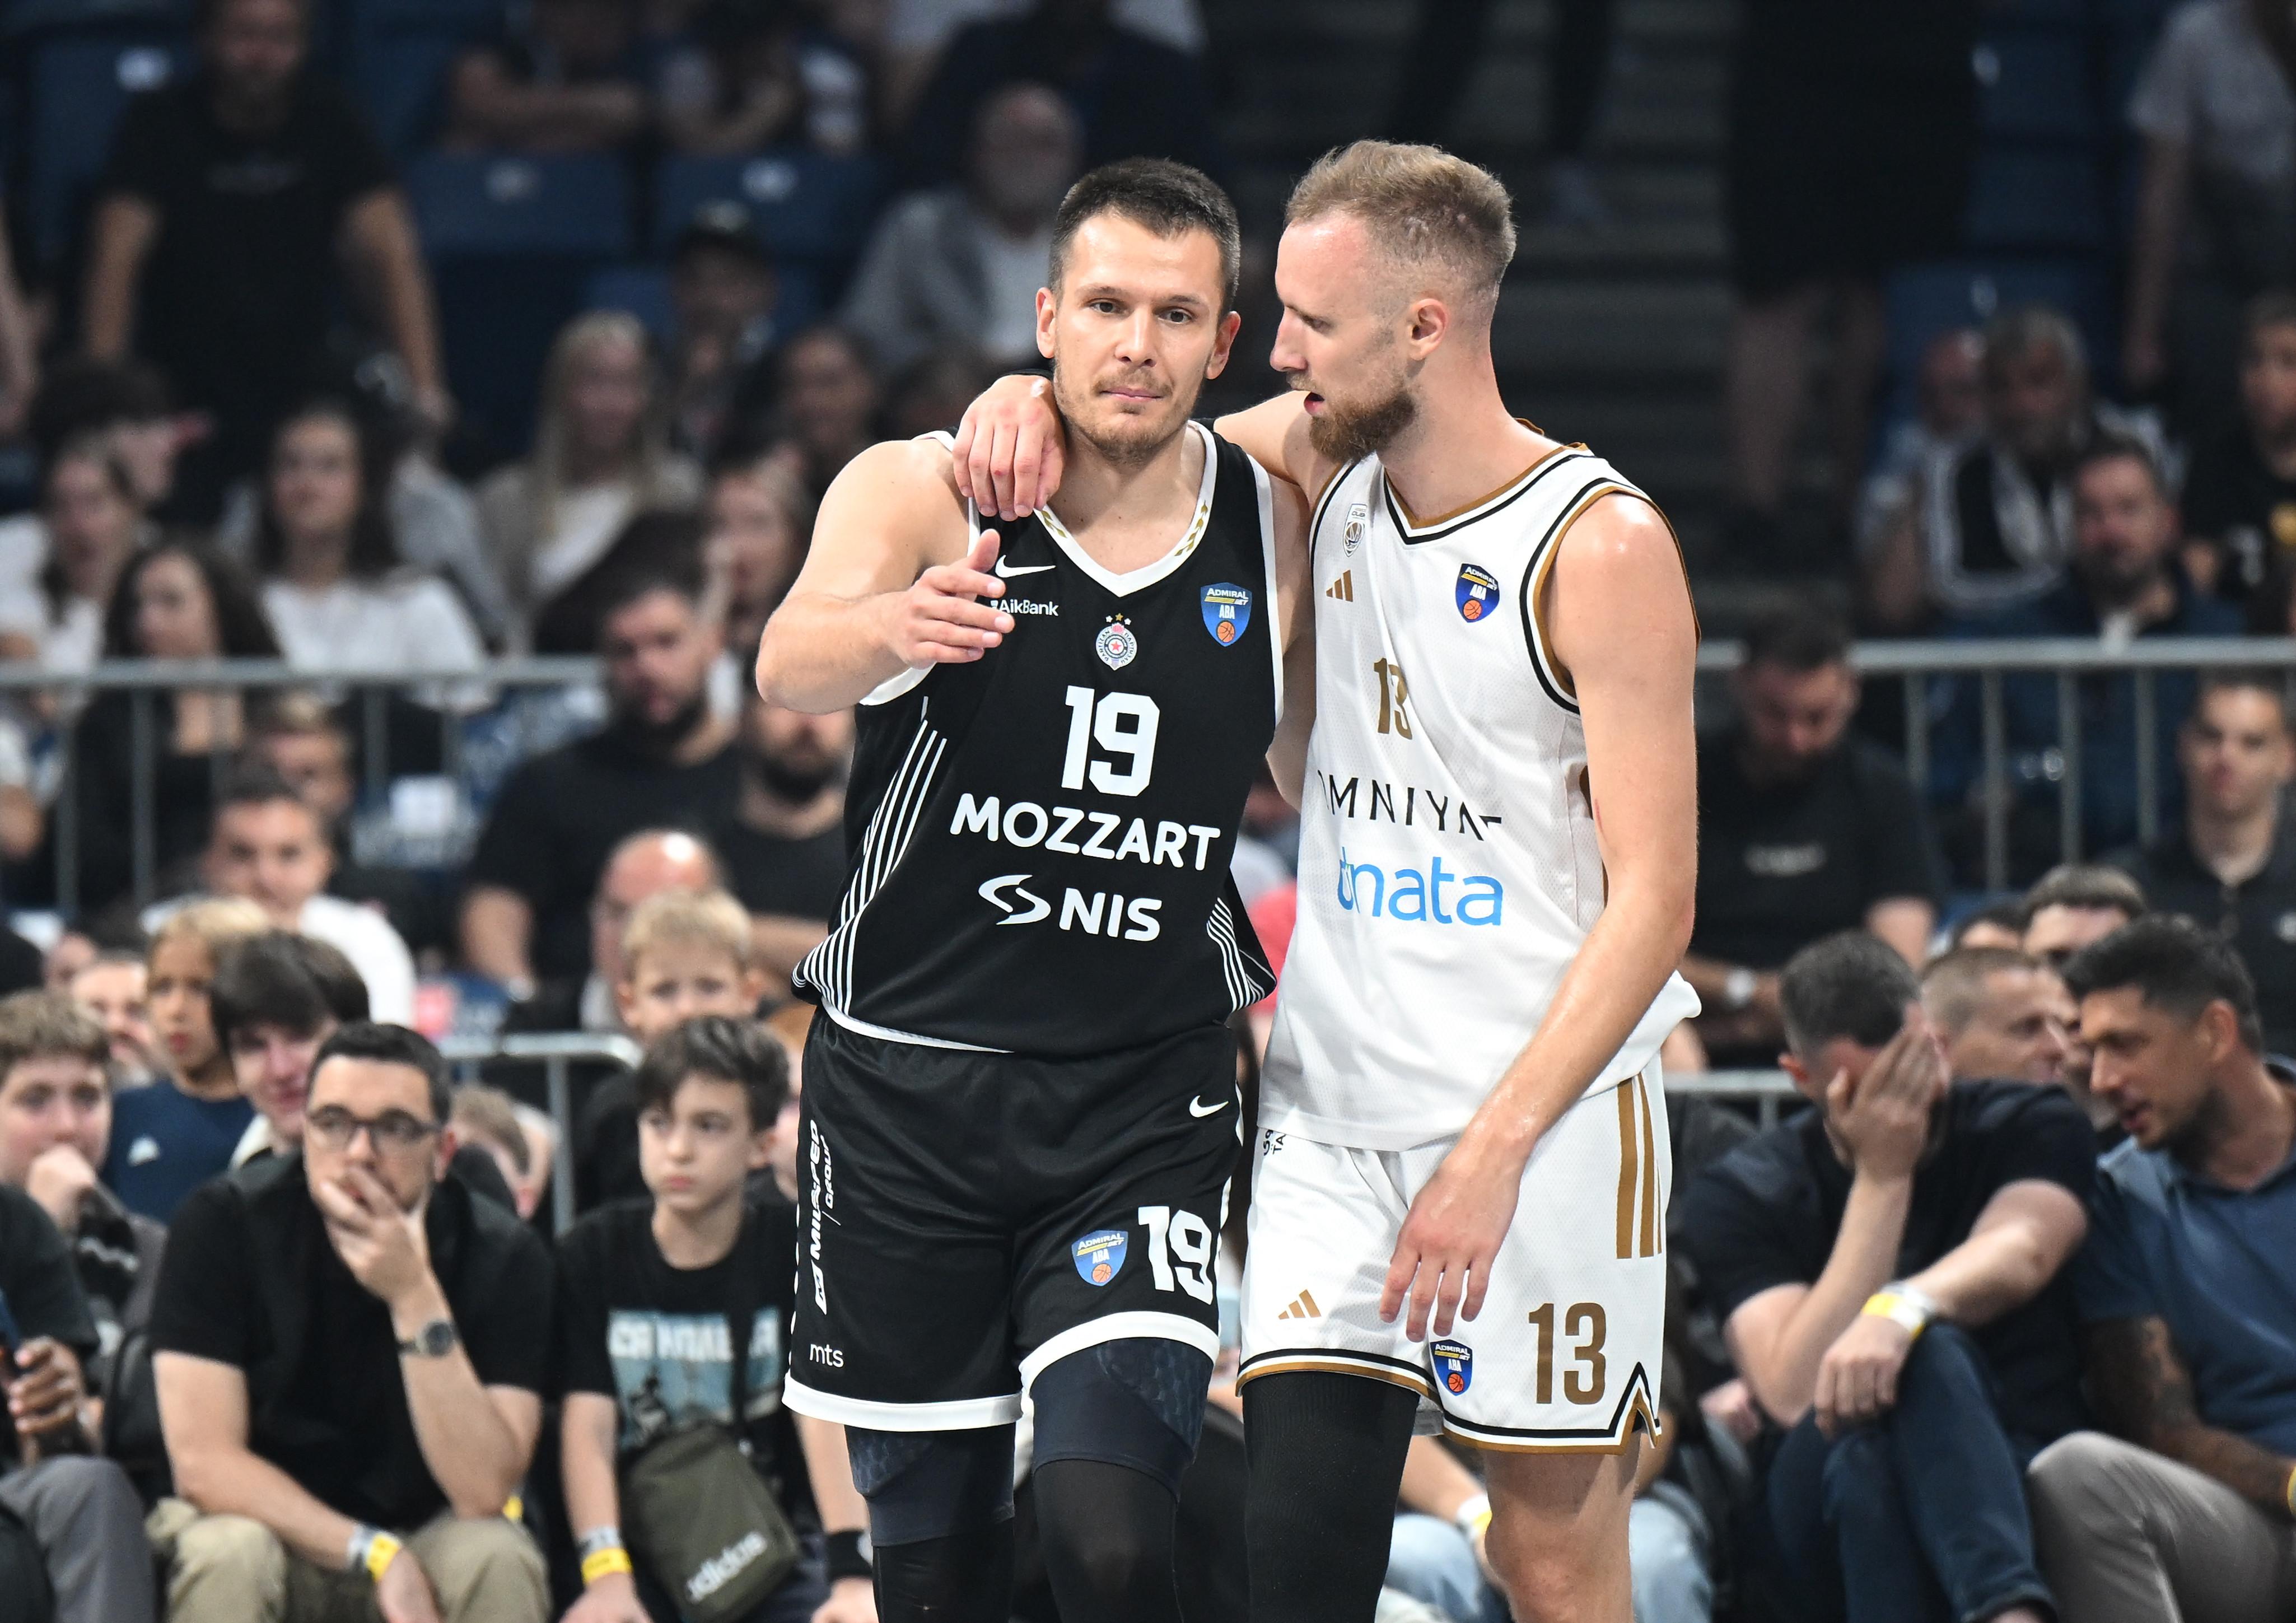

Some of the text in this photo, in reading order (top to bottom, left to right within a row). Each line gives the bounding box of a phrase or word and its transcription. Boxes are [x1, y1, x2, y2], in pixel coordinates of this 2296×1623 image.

[1464, 566, 1497, 587] ADMIRAL
[1207, 587, 1249, 600] ADMIRAL
[1469, 584, 1487, 600] ABA
[998, 599, 1059, 617] AikBank
[1219, 604, 1235, 619] ABA
[1061, 685, 1160, 797] 19
[949, 792, 1221, 871] MOZZART
[1058, 887, 1163, 941] NIS
[1077, 1233, 1125, 1251] ADMIRAL
[1092, 1248, 1110, 1264] ABA
[1137, 1205, 1214, 1306] 19
[809, 1344, 844, 1368] mts
[1435, 1344, 1471, 1356] ADMIRAL
[1528, 1302, 1607, 1405] 13
[1448, 1358, 1462, 1372] ABA
